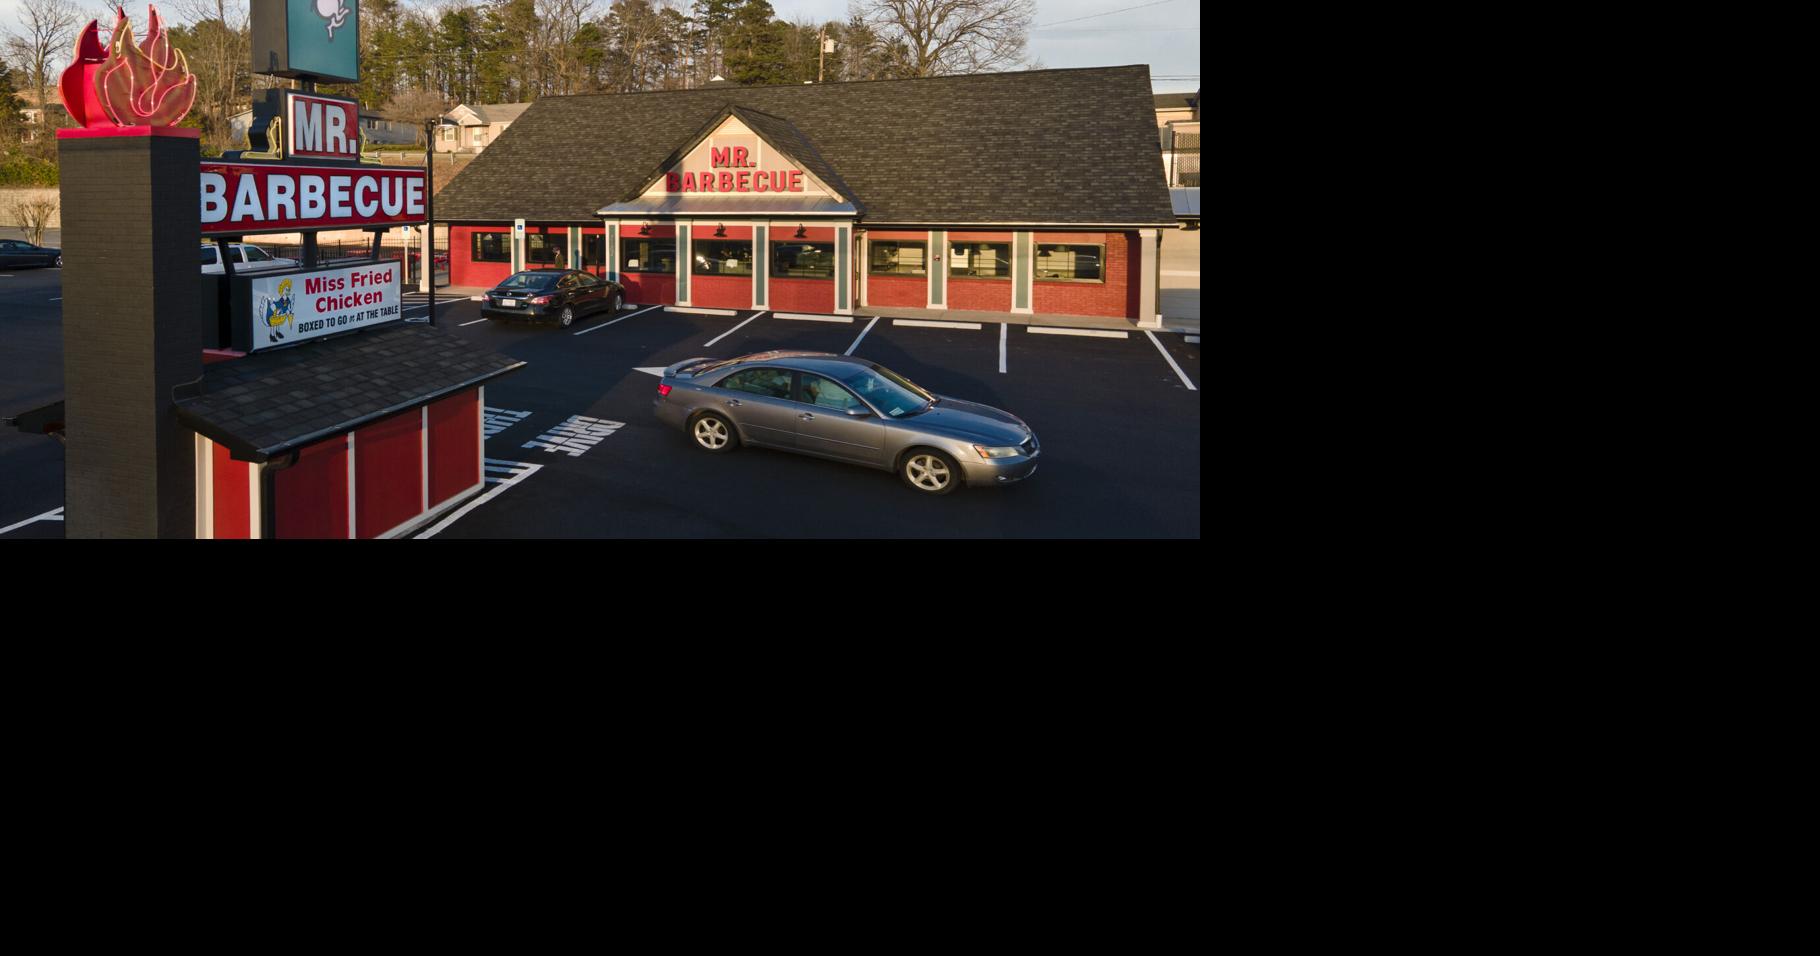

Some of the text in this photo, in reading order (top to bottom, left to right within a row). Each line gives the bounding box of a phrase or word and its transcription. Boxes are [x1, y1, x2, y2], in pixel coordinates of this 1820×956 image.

[295, 100, 357, 154] MR.
[711, 146, 757, 168] MR.
[666, 170, 804, 193] BARBECUE
[200, 172, 425, 223] BARBECUE
[305, 268, 392, 295] Miss Fried
[315, 290, 383, 313] Chicken
[298, 319, 324, 333] BOXED
[326, 317, 336, 328] TO
[337, 315, 347, 325] GO
[356, 311, 365, 322] AT
[367, 308, 378, 319] THE
[380, 305, 399, 316] TABLE
